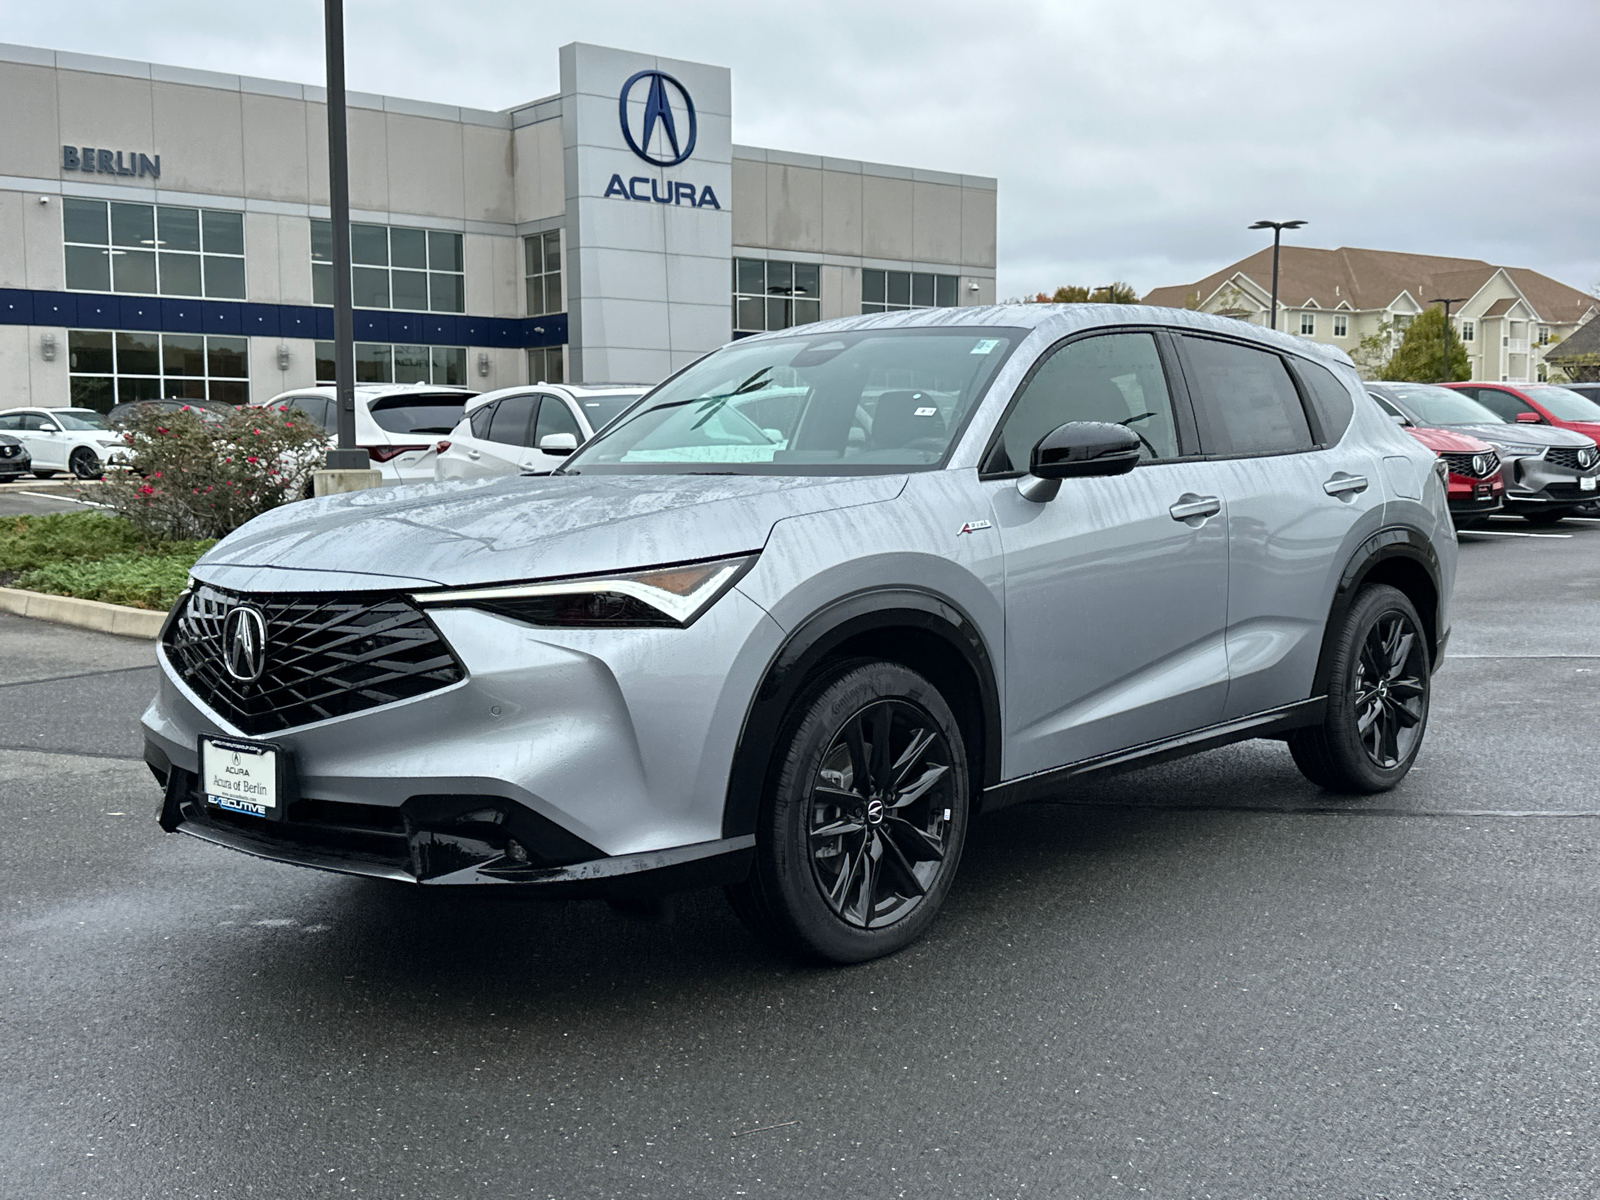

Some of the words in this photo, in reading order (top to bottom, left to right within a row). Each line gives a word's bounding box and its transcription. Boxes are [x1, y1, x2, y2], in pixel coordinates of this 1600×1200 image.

[62, 145, 160, 179] BERLIN
[603, 173, 721, 210] ACURA
[225, 766, 250, 777] ACURA
[213, 775, 232, 792] Acura
[233, 780, 241, 791] of
[243, 780, 267, 796] Berlin
[208, 795, 266, 815] EXECUTIVE
